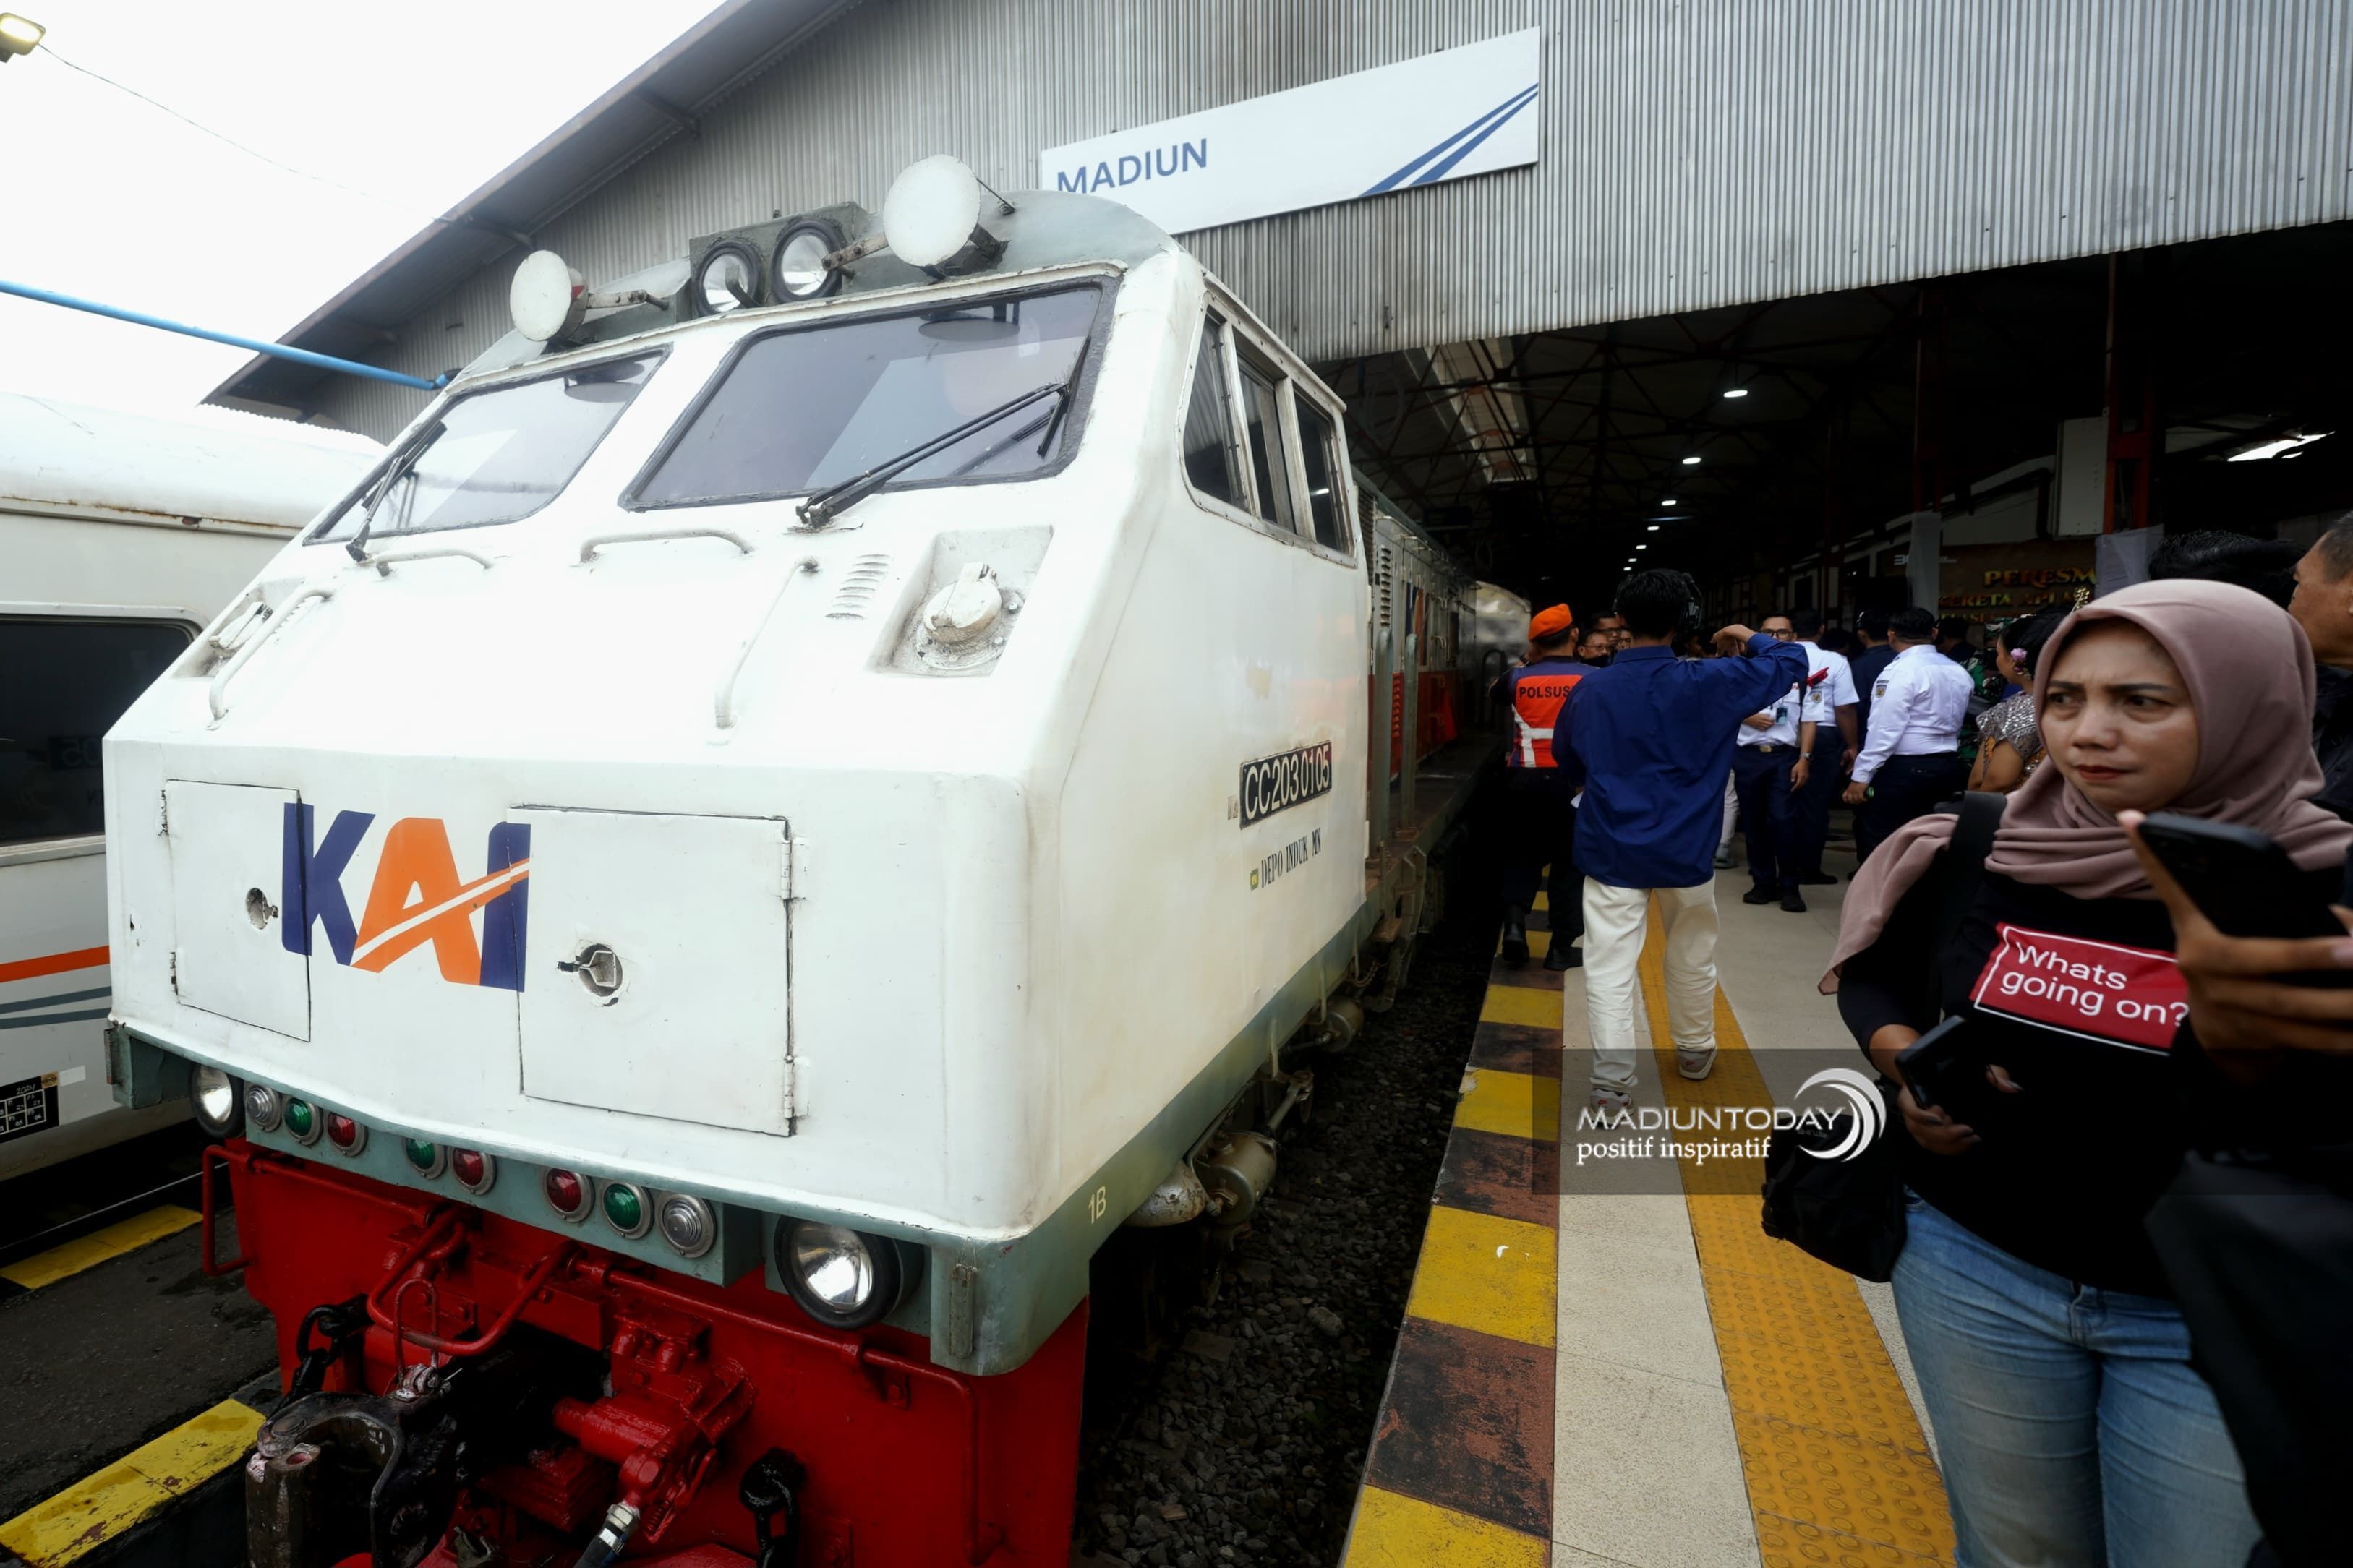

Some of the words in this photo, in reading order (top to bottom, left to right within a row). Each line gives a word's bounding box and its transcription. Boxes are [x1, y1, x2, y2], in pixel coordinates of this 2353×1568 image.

[1057, 138, 1207, 194] MADIUN
[1261, 850, 1283, 888] DEPO
[1286, 835, 1308, 873] INDUK
[1312, 828, 1321, 857] MN
[281, 802, 531, 993] KAI
[2015, 941, 2127, 990] Whats
[2000, 971, 2104, 1016] going
[2116, 999, 2190, 1027] on?
[1088, 1186, 1106, 1224] 1B
